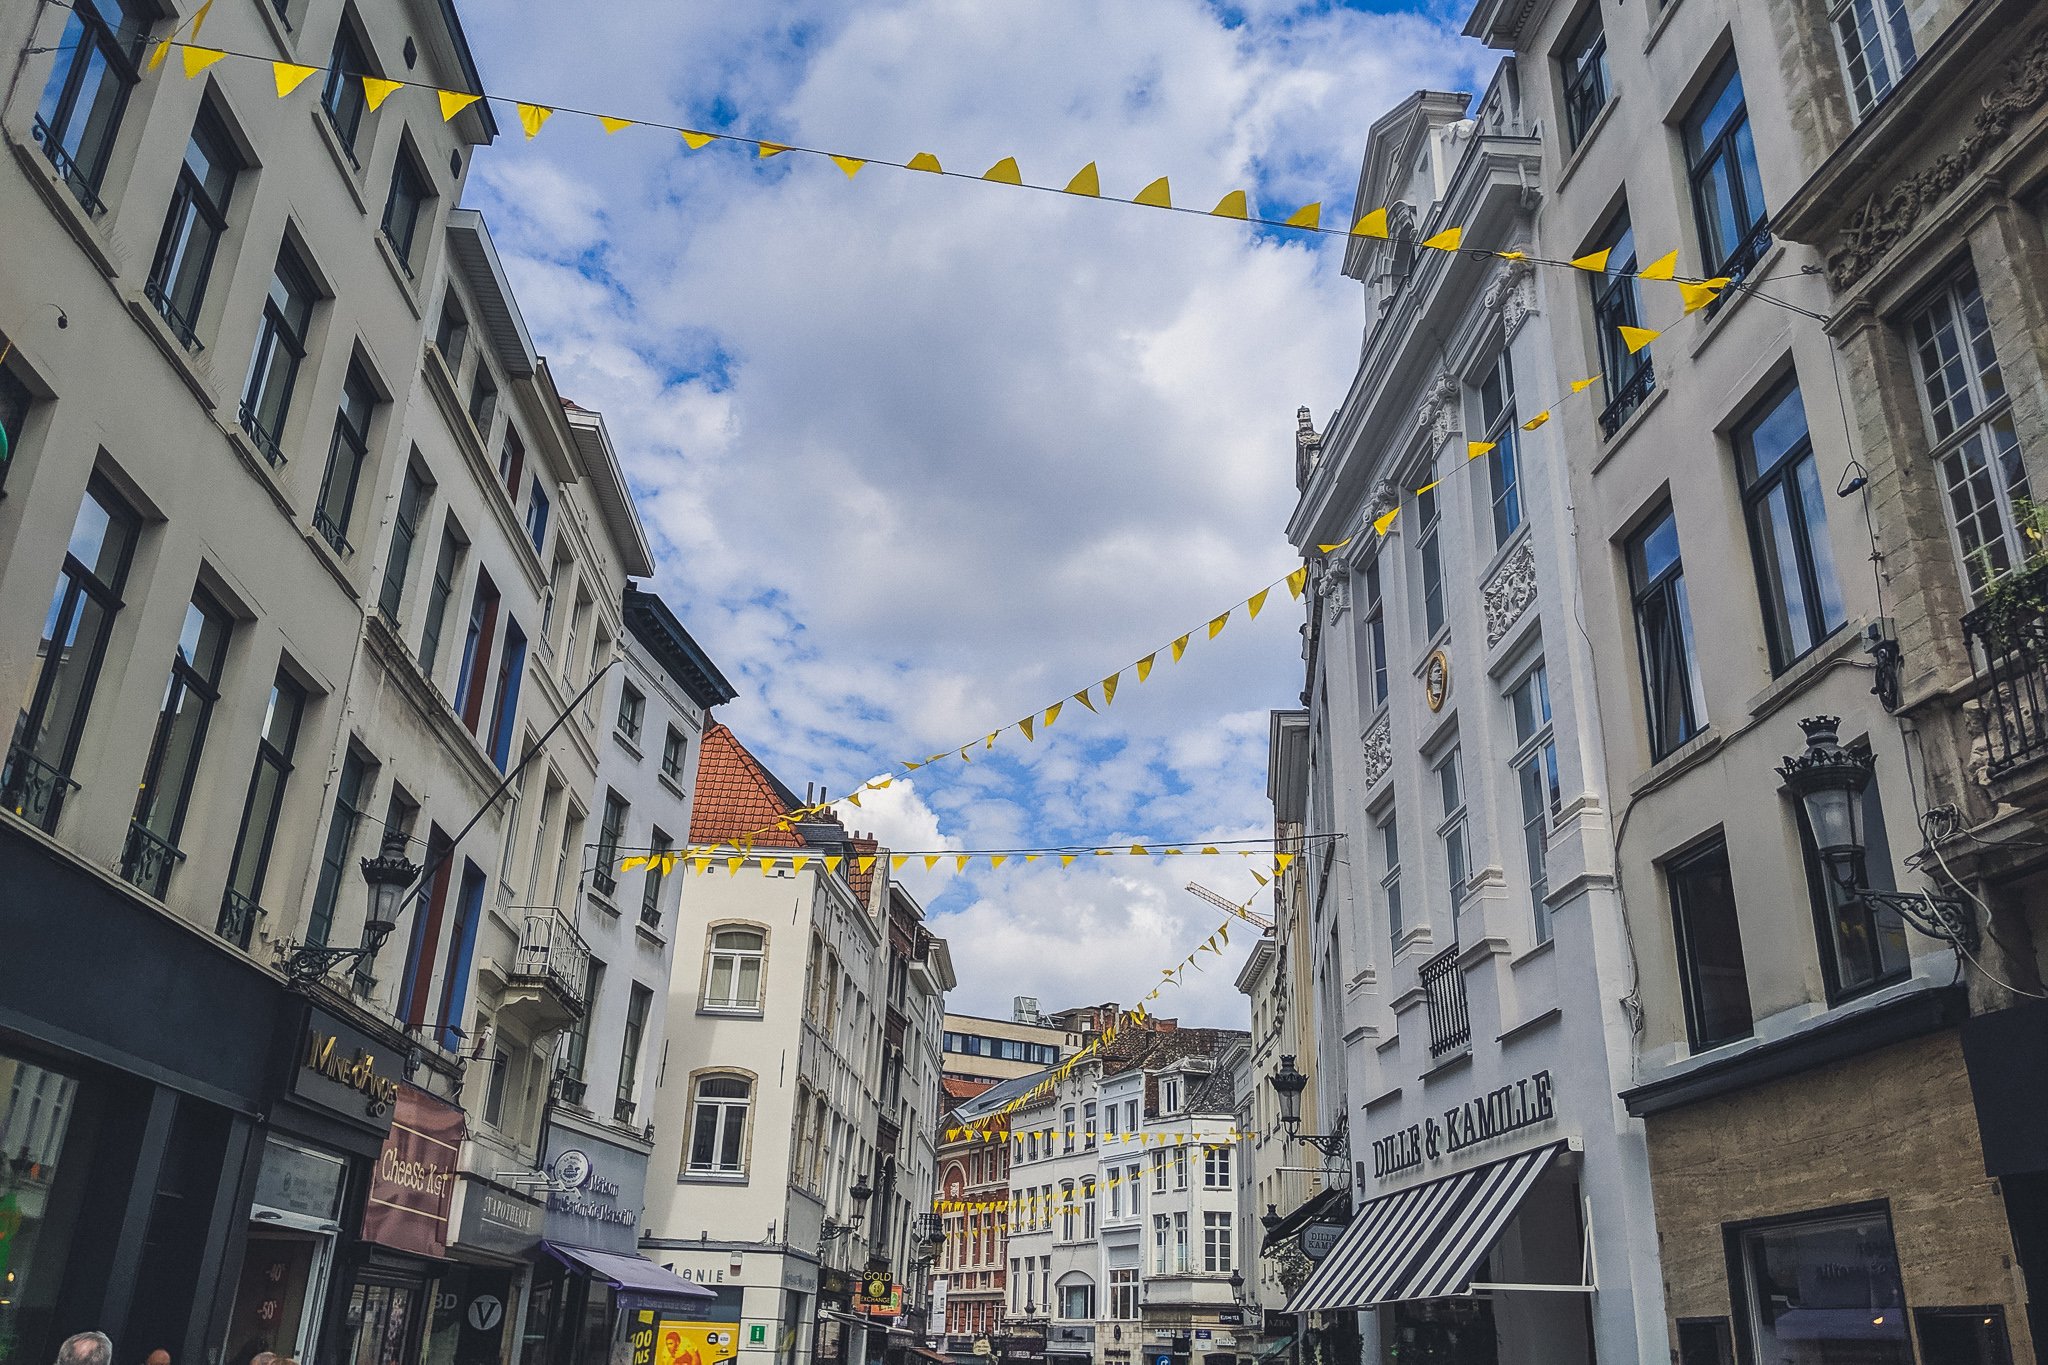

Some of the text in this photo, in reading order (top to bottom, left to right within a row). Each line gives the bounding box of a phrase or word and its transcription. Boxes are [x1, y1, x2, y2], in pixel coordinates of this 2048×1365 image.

[1372, 1069, 1554, 1178] DILLE & KAMILLE
[382, 1147, 425, 1191] Cheese
[863, 1271, 892, 1282] GOLD
[861, 1296, 891, 1304] EXCHANGE
